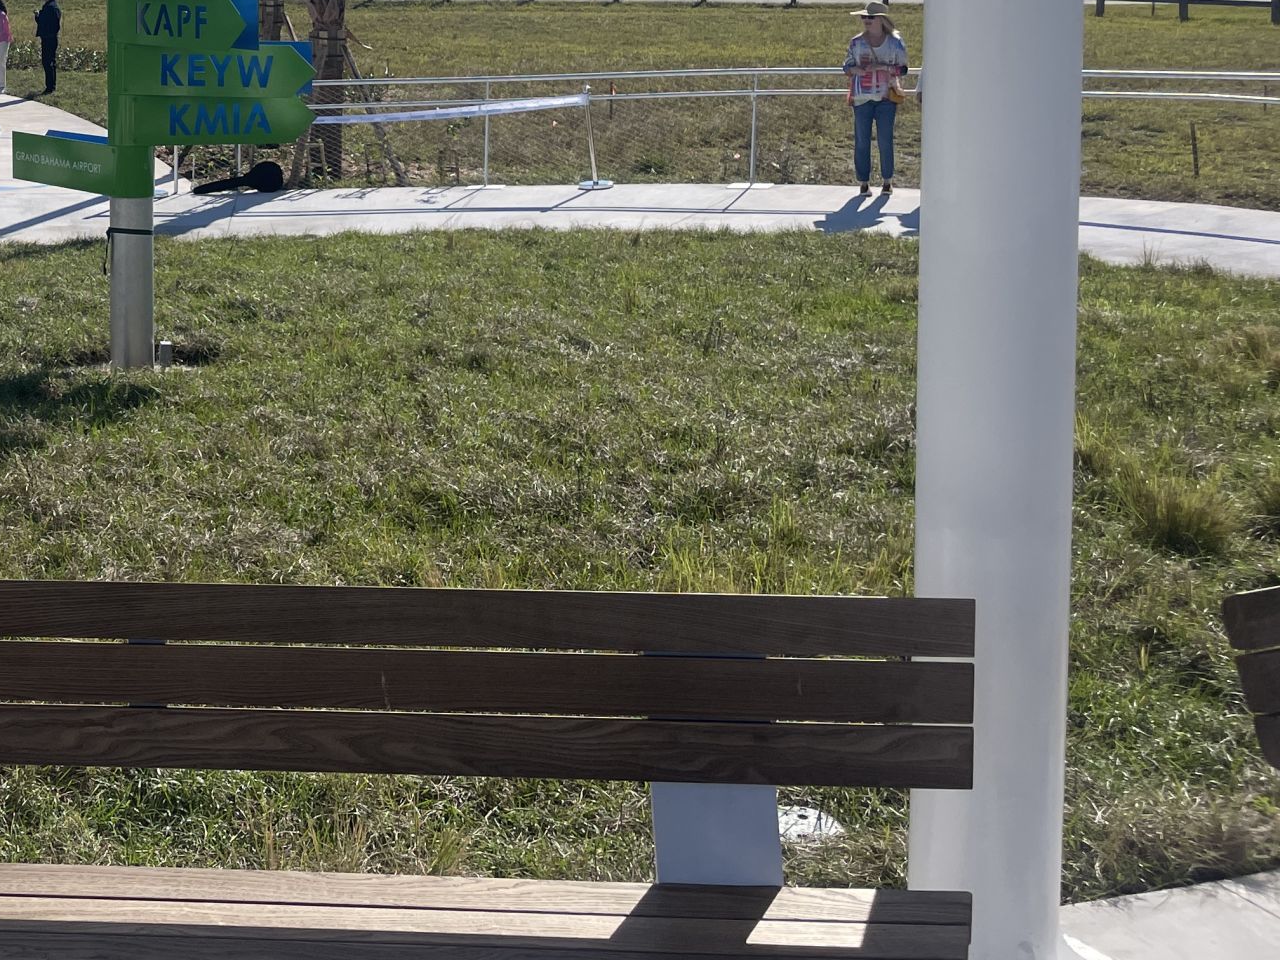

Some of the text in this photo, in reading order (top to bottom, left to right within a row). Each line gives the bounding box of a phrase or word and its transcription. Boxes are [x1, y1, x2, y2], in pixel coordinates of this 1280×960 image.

[135, 0, 208, 39] KAPF
[160, 53, 274, 89] KEYW
[169, 102, 272, 137] KMIA
[15, 150, 102, 174] GRAND BAHAMA AIRPORT
